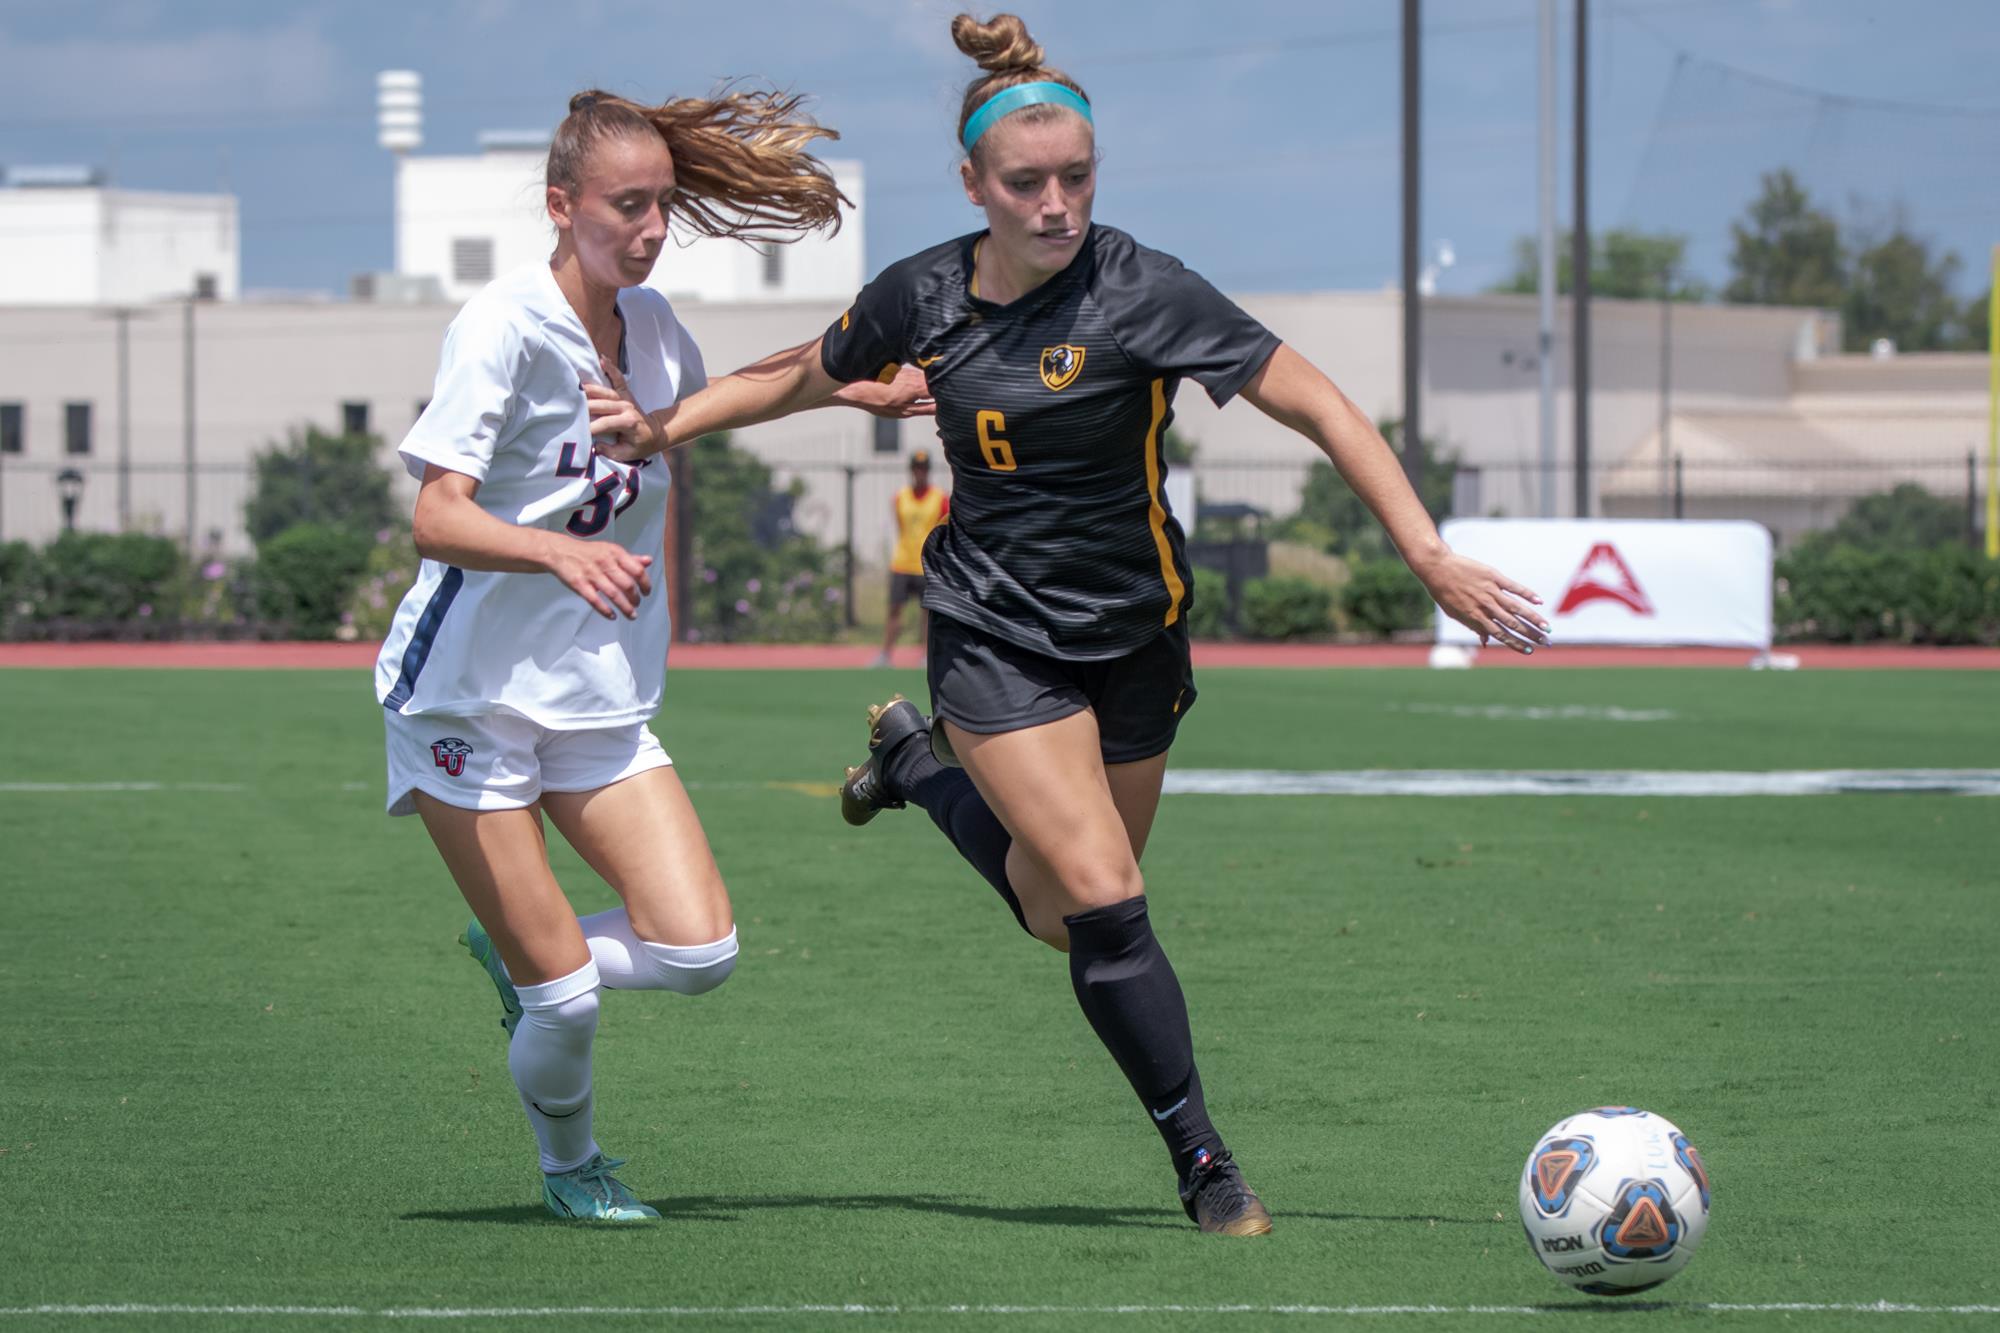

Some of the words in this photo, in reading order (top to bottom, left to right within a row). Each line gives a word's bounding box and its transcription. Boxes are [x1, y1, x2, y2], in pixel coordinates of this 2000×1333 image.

[976, 409, 1017, 471] 6
[1554, 542, 1655, 616] A
[431, 744, 467, 777] LU
[1541, 1234, 1584, 1252] NCAA
